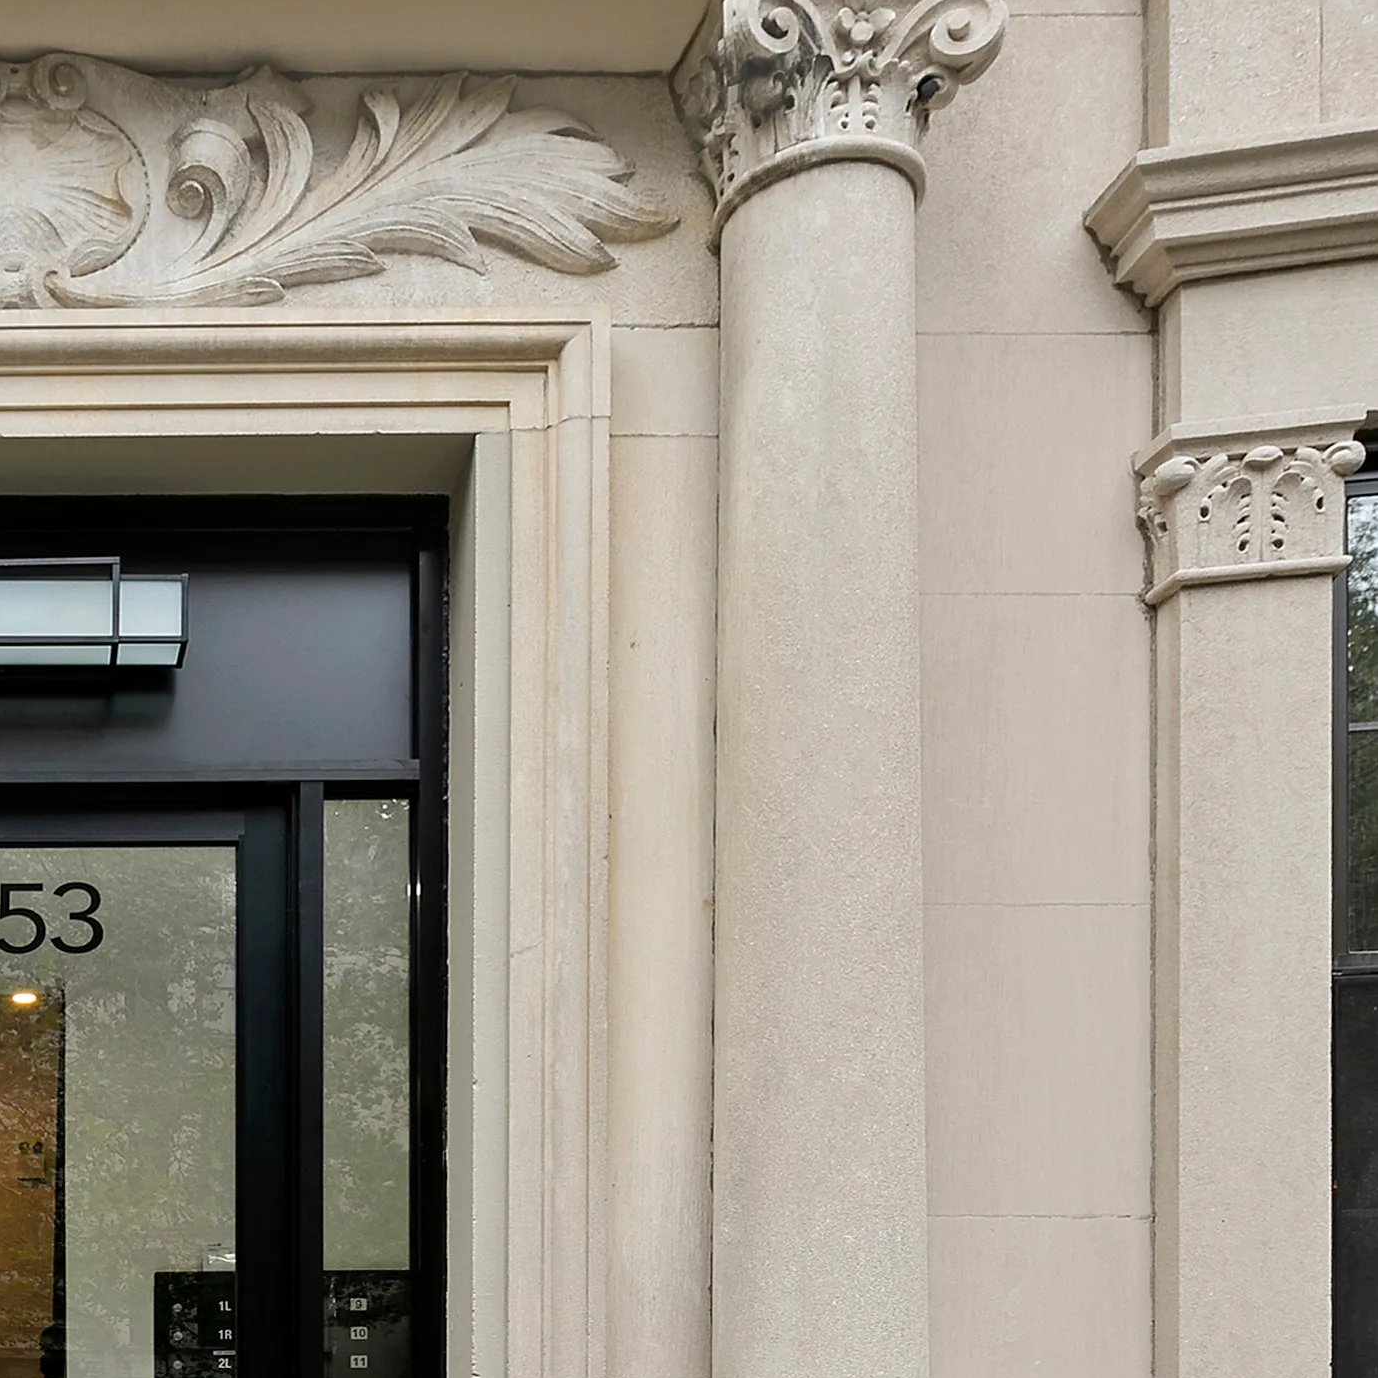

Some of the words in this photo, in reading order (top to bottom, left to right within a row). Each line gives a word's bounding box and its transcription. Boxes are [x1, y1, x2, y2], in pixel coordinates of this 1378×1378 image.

[218, 1300, 232, 1311] 1L
[355, 1299, 362, 1310] 9
[218, 1329, 233, 1340] 1R
[352, 1328, 366, 1338] 10
[217, 1358, 232, 1369] 2L
[352, 1357, 366, 1367] 11
